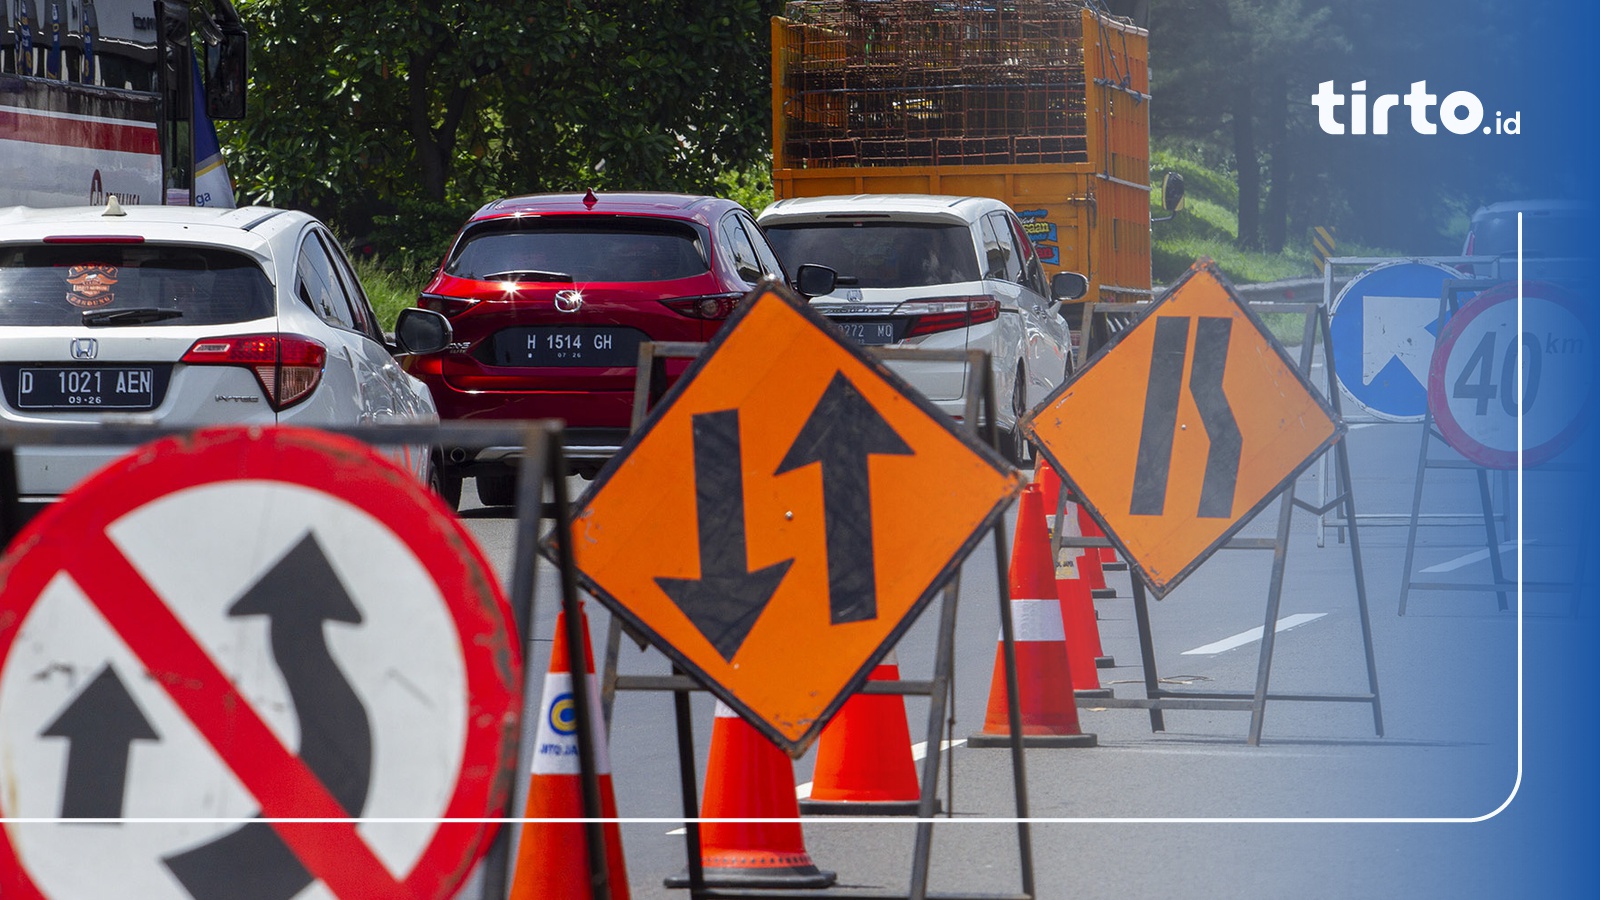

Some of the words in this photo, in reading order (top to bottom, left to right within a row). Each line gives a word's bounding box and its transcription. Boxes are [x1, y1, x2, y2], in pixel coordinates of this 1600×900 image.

[527, 334, 536, 349] H
[546, 334, 582, 349] 1514
[593, 334, 612, 349] GH
[21, 371, 33, 393] D
[58, 371, 101, 393] 1021
[115, 371, 151, 393] AEN
[1452, 331, 1542, 418] 40
[1545, 332, 1584, 354] km
